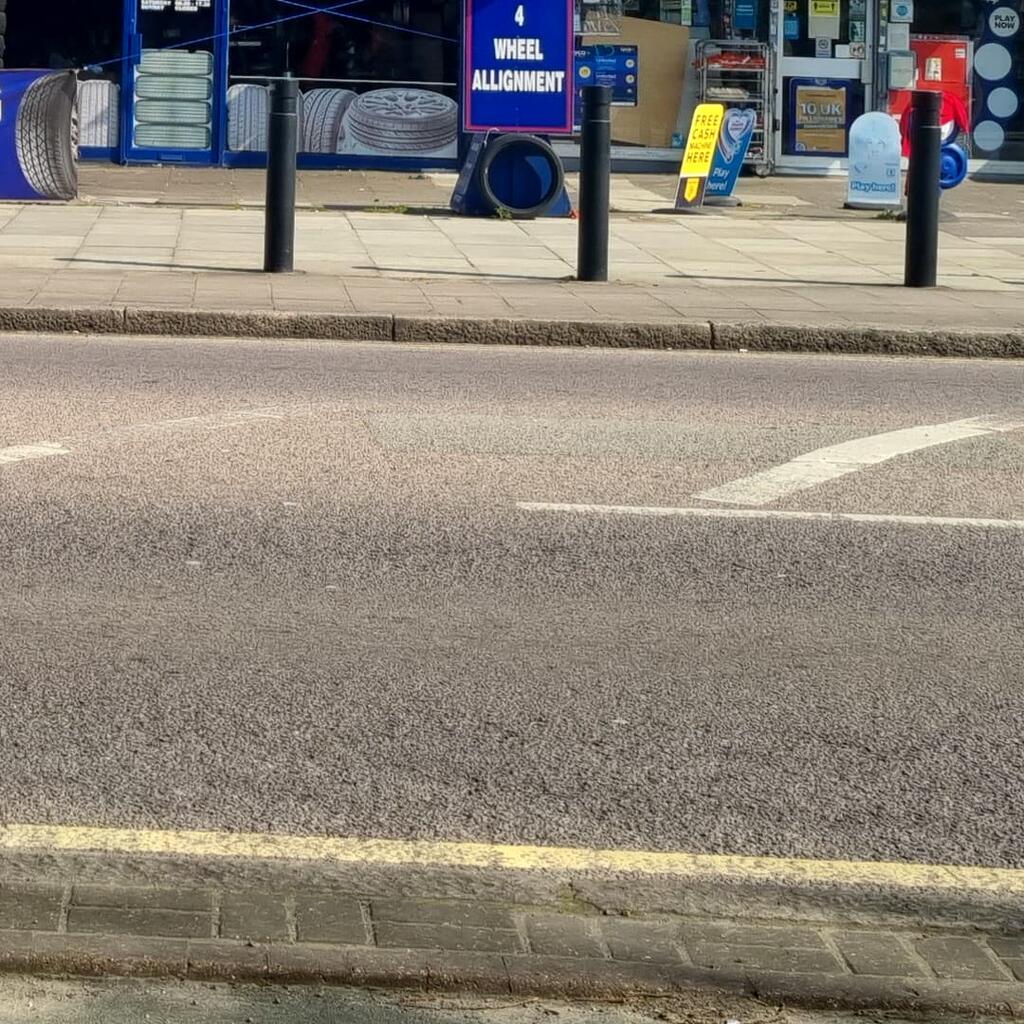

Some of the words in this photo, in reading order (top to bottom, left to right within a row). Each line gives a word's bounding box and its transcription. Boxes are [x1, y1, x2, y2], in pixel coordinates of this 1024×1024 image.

[514, 4, 525, 27] 4
[994, 15, 1016, 23] PLAY
[994, 21, 1016, 30] NOW
[493, 38, 544, 61] WHEEL
[471, 68, 566, 93] ALLIGNMENT
[695, 114, 719, 127] FREE
[692, 128, 716, 141] CASH
[686, 150, 710, 164] HERE
[712, 167, 730, 180] Play
